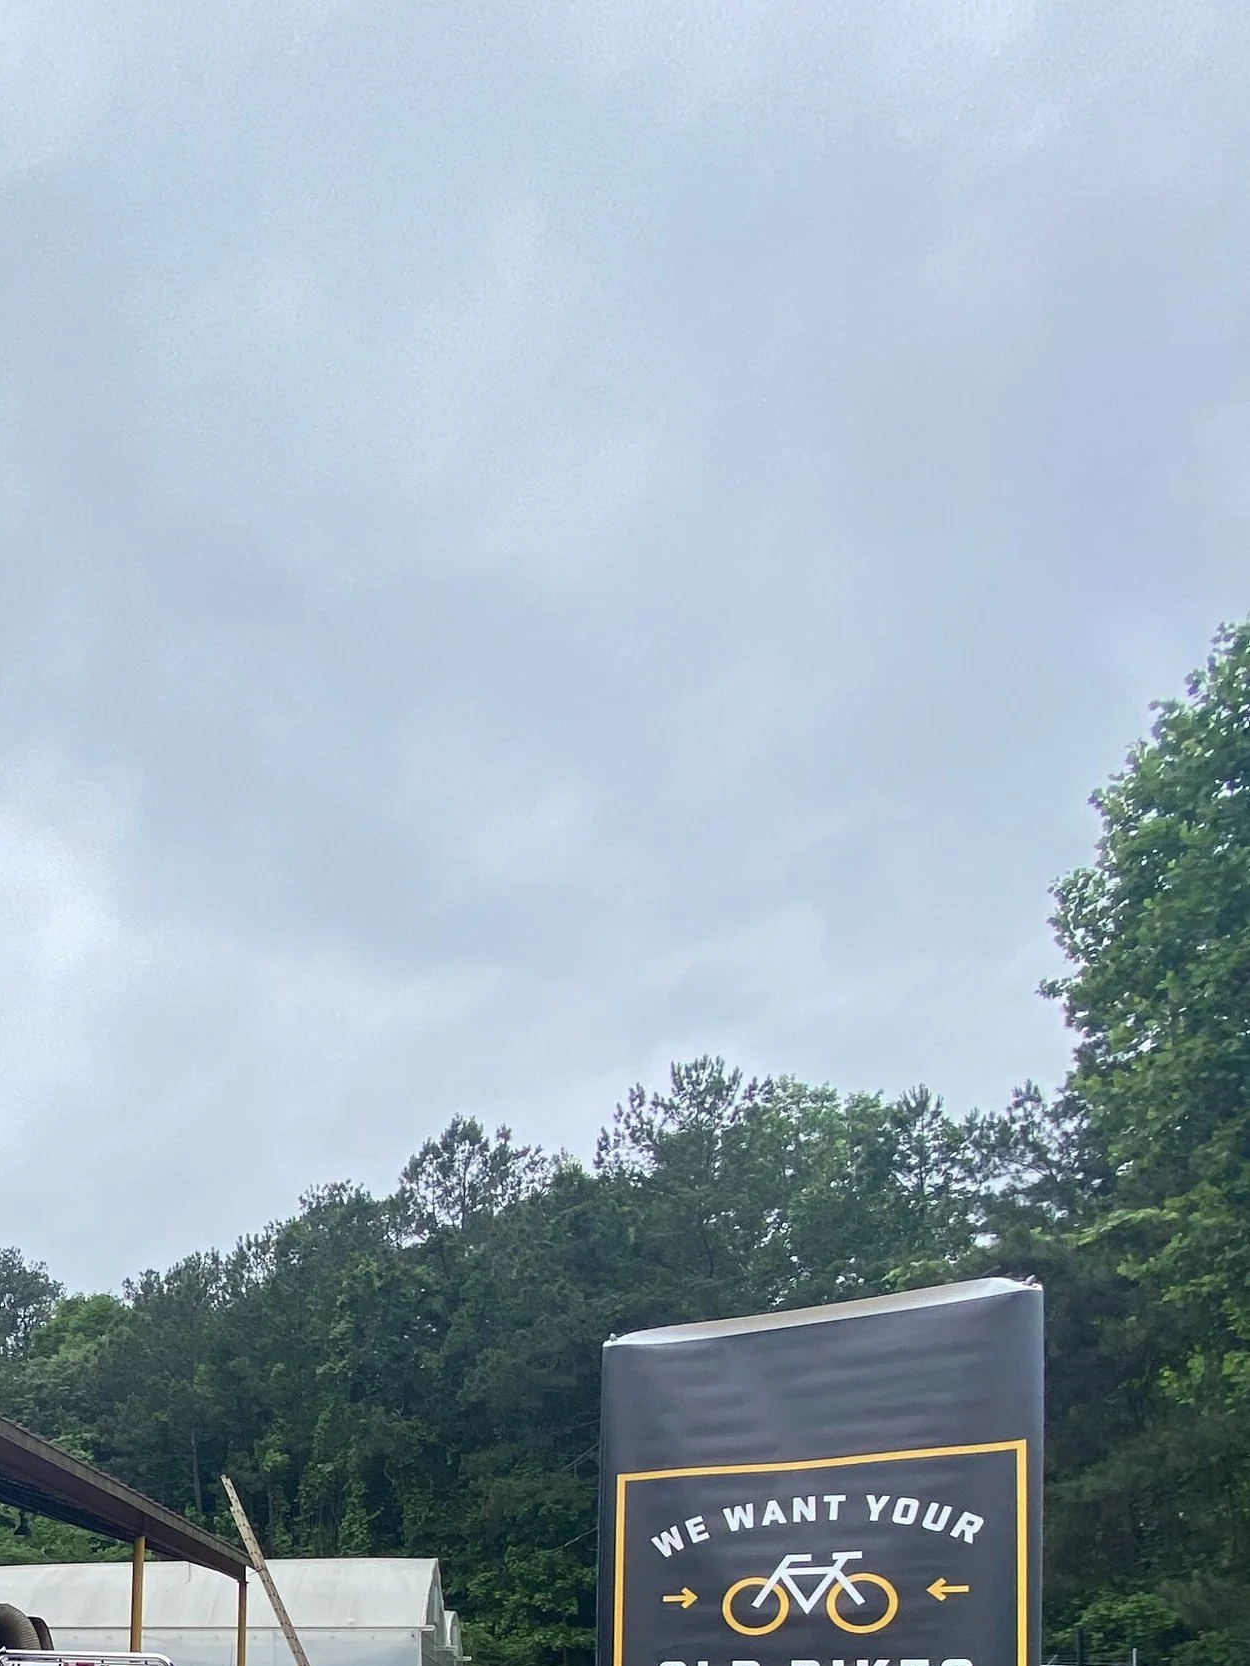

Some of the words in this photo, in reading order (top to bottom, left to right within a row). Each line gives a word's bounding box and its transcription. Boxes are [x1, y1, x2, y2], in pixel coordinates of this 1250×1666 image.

[651, 1516, 710, 1558] WE
[723, 1495, 846, 1532] WANT
[866, 1495, 985, 1545] YOUR
